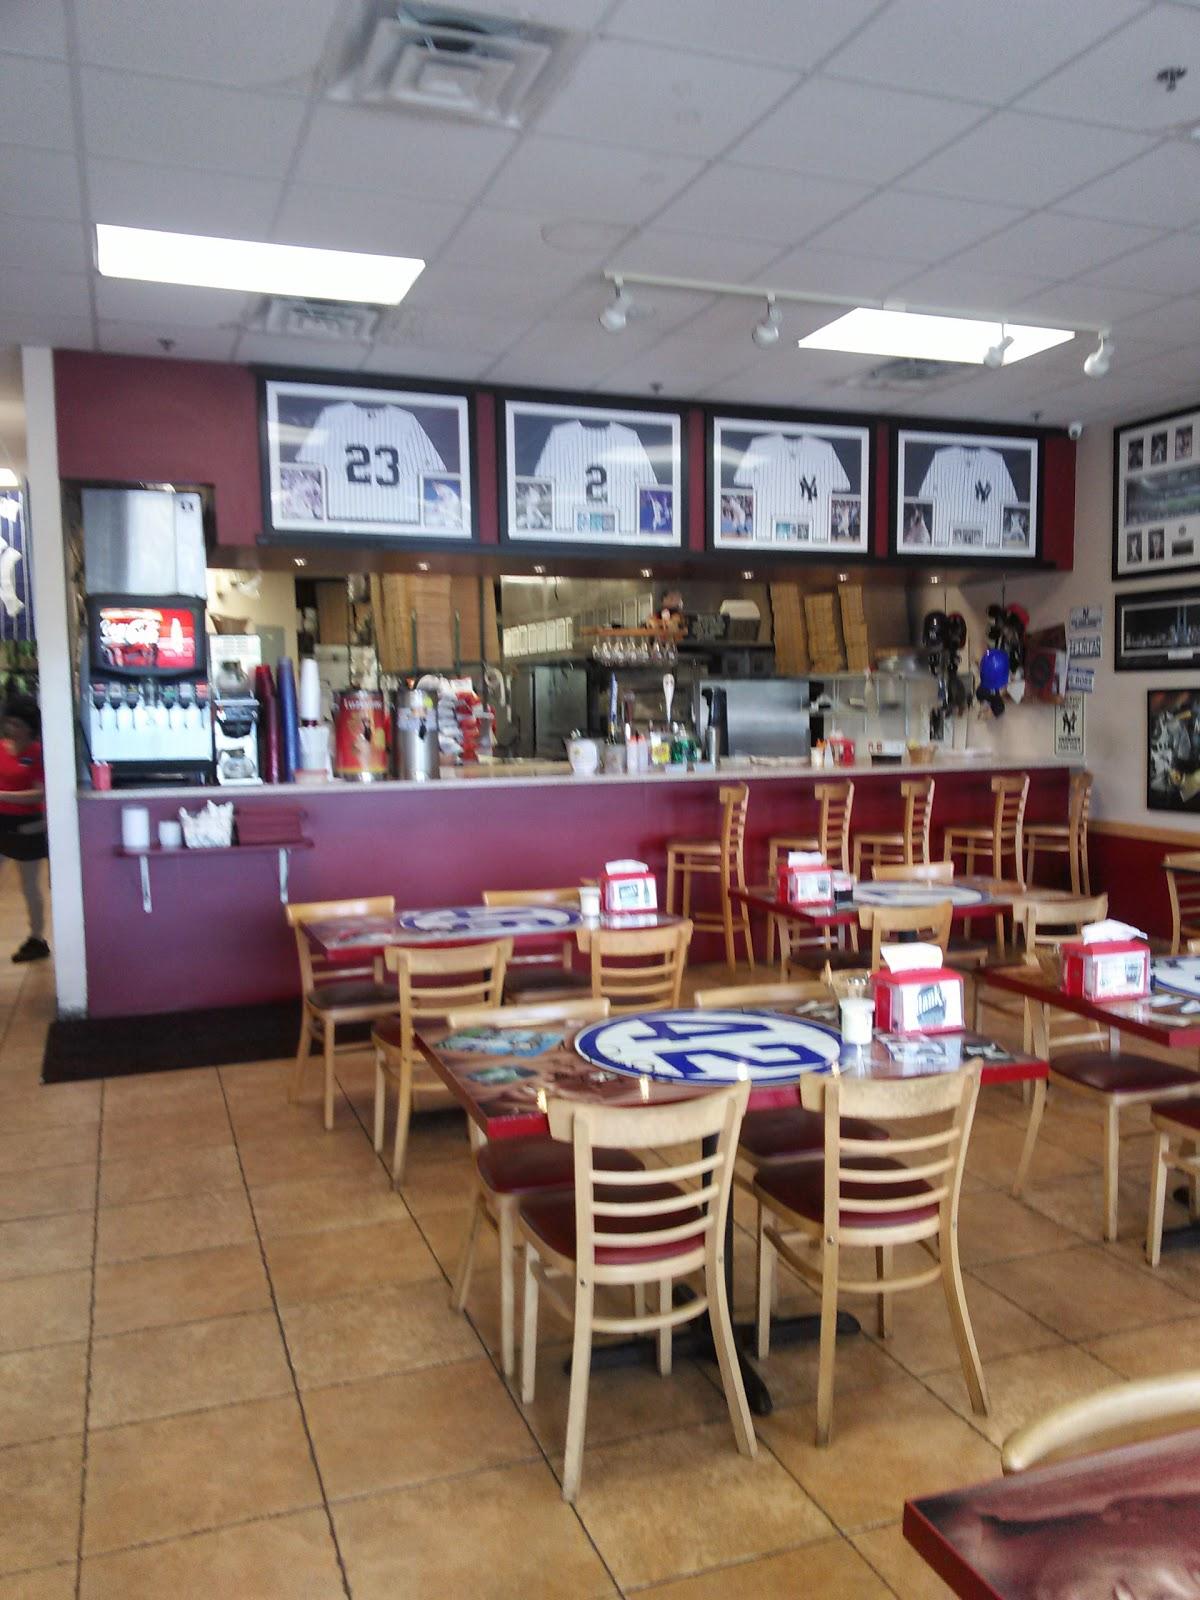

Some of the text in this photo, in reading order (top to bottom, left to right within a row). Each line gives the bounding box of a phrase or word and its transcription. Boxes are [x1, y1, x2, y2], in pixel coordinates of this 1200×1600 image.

[345, 443, 400, 487] 23
[585, 464, 608, 504] 2
[799, 475, 818, 502] NY
[975, 479, 992, 502] NY
